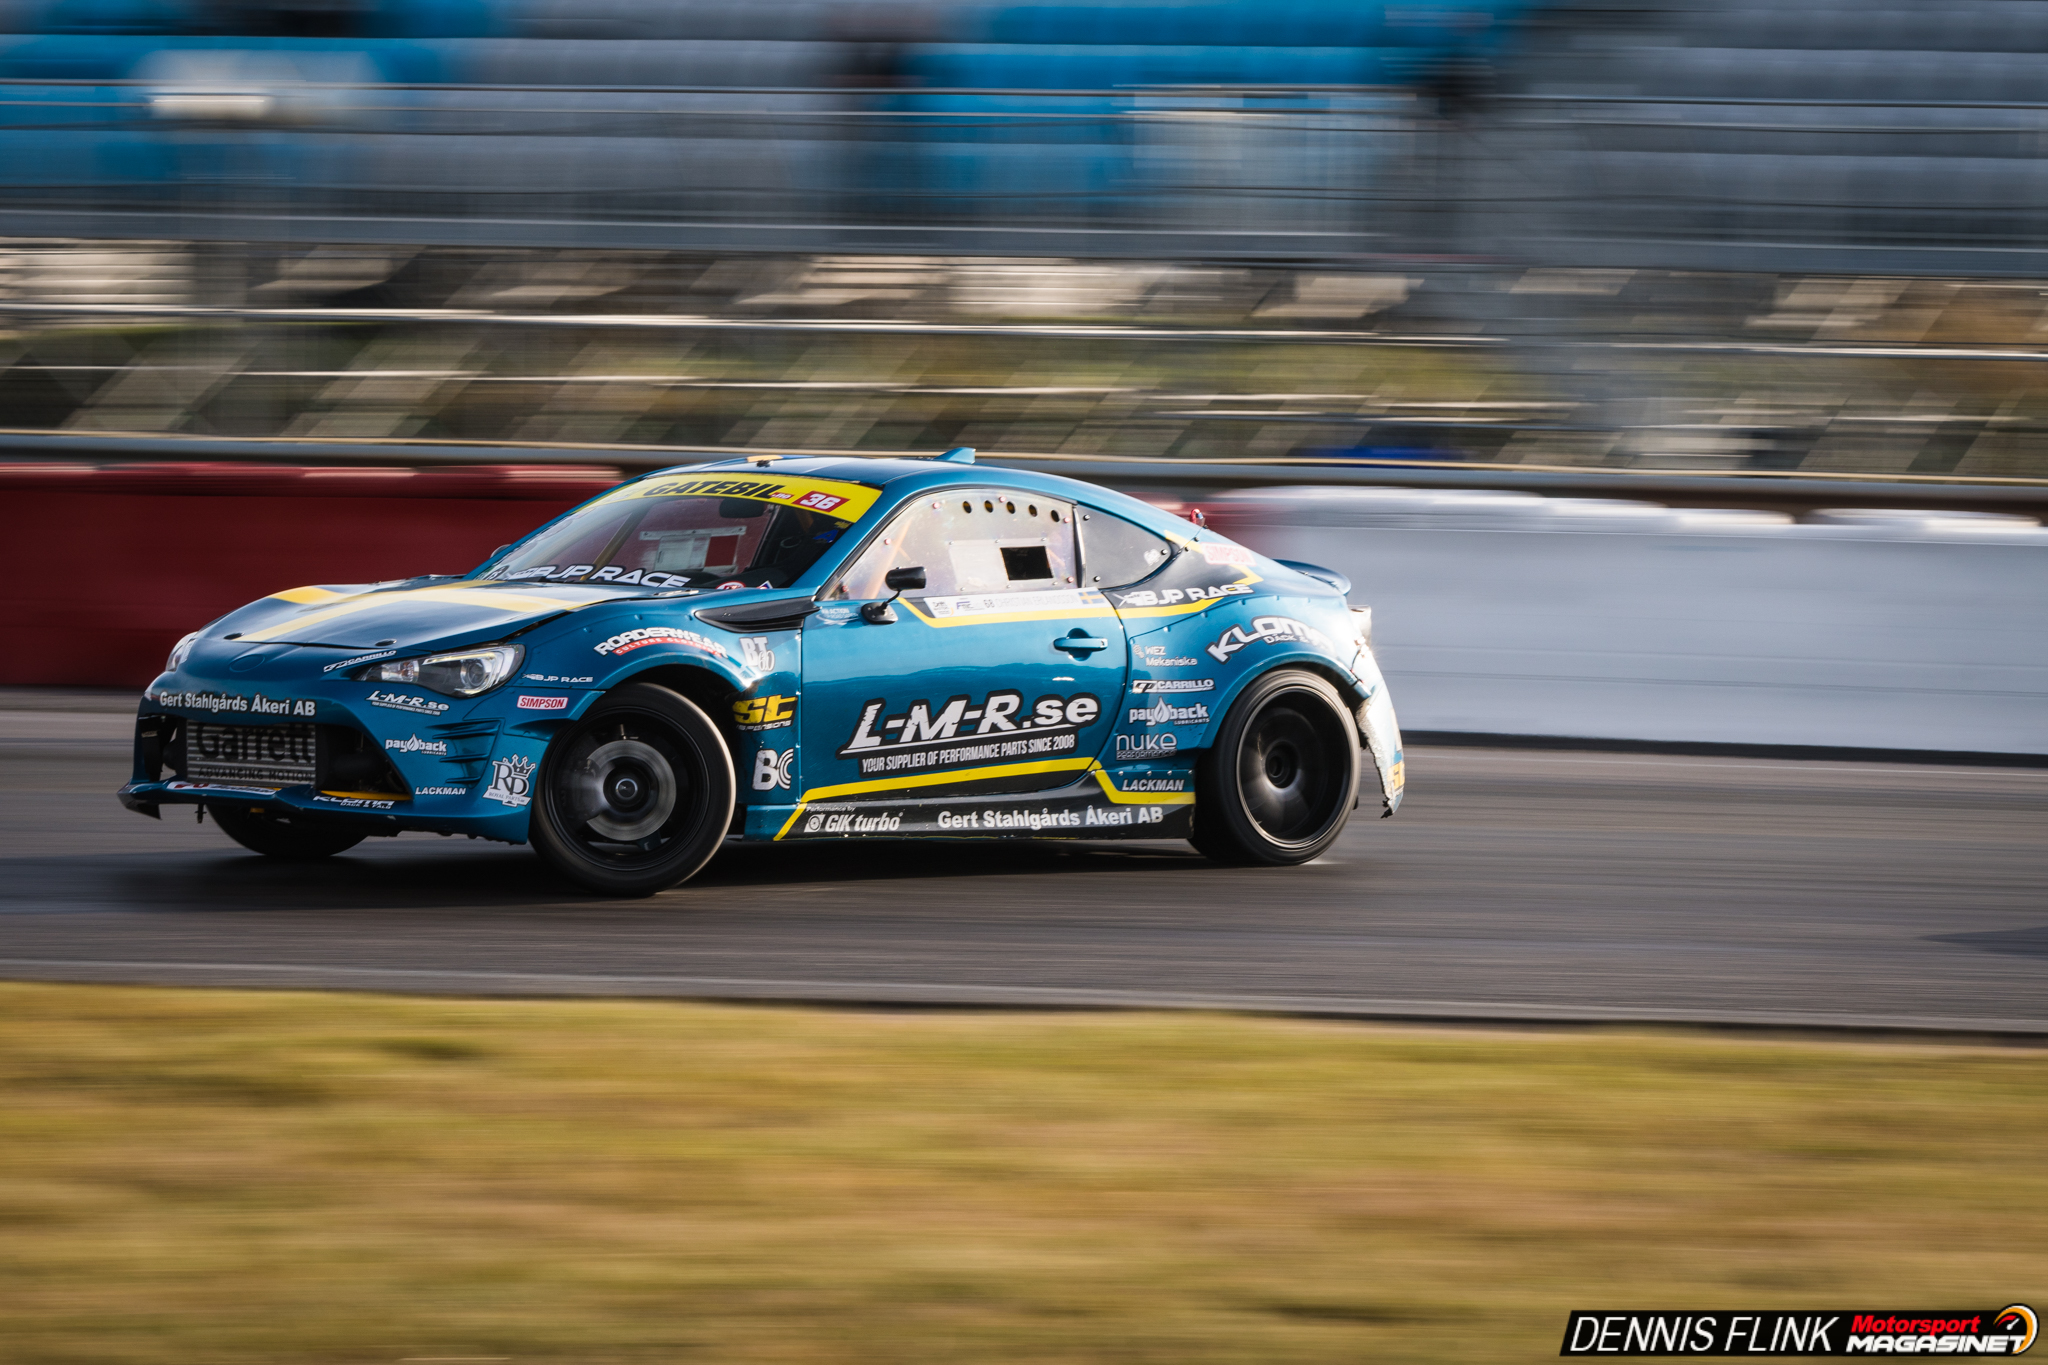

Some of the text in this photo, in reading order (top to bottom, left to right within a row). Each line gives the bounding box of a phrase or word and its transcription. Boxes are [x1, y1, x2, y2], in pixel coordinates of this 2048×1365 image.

[799, 493, 842, 509] 36
[590, 565, 691, 588] RACE
[1142, 583, 1254, 606] BJP RACE
[593, 627, 729, 659] ROADERWEAR
[616, 637, 662, 654] CULTURE
[739, 636, 768, 667] BT
[1144, 646, 1166, 656] WEZ
[348, 650, 397, 664] CARRILLO
[1146, 656, 1198, 667] Mekaniska
[536, 674, 559, 682] BJP
[1157, 679, 1214, 690] CARRILLO
[160, 692, 316, 716] Gert Stahlgårds Åkeri AB
[368, 690, 449, 711] L-M-R.se
[520, 697, 565, 708] SIMPSON
[847, 694, 1099, 750] L-M-R.se
[1174, 717, 1210, 725] LUBRICANTS
[196, 722, 312, 763] Garrett
[1116, 733, 1177, 751] nuke
[862, 734, 1075, 773] YOUR SUPPLIER OF PERFORMANCE PARTS SINCE 2008
[415, 786, 466, 796] LACKMAN
[1122, 779, 1185, 791] LACKMAN
[938, 806, 1163, 831] Gert Stahlgårds Åkeri AB
